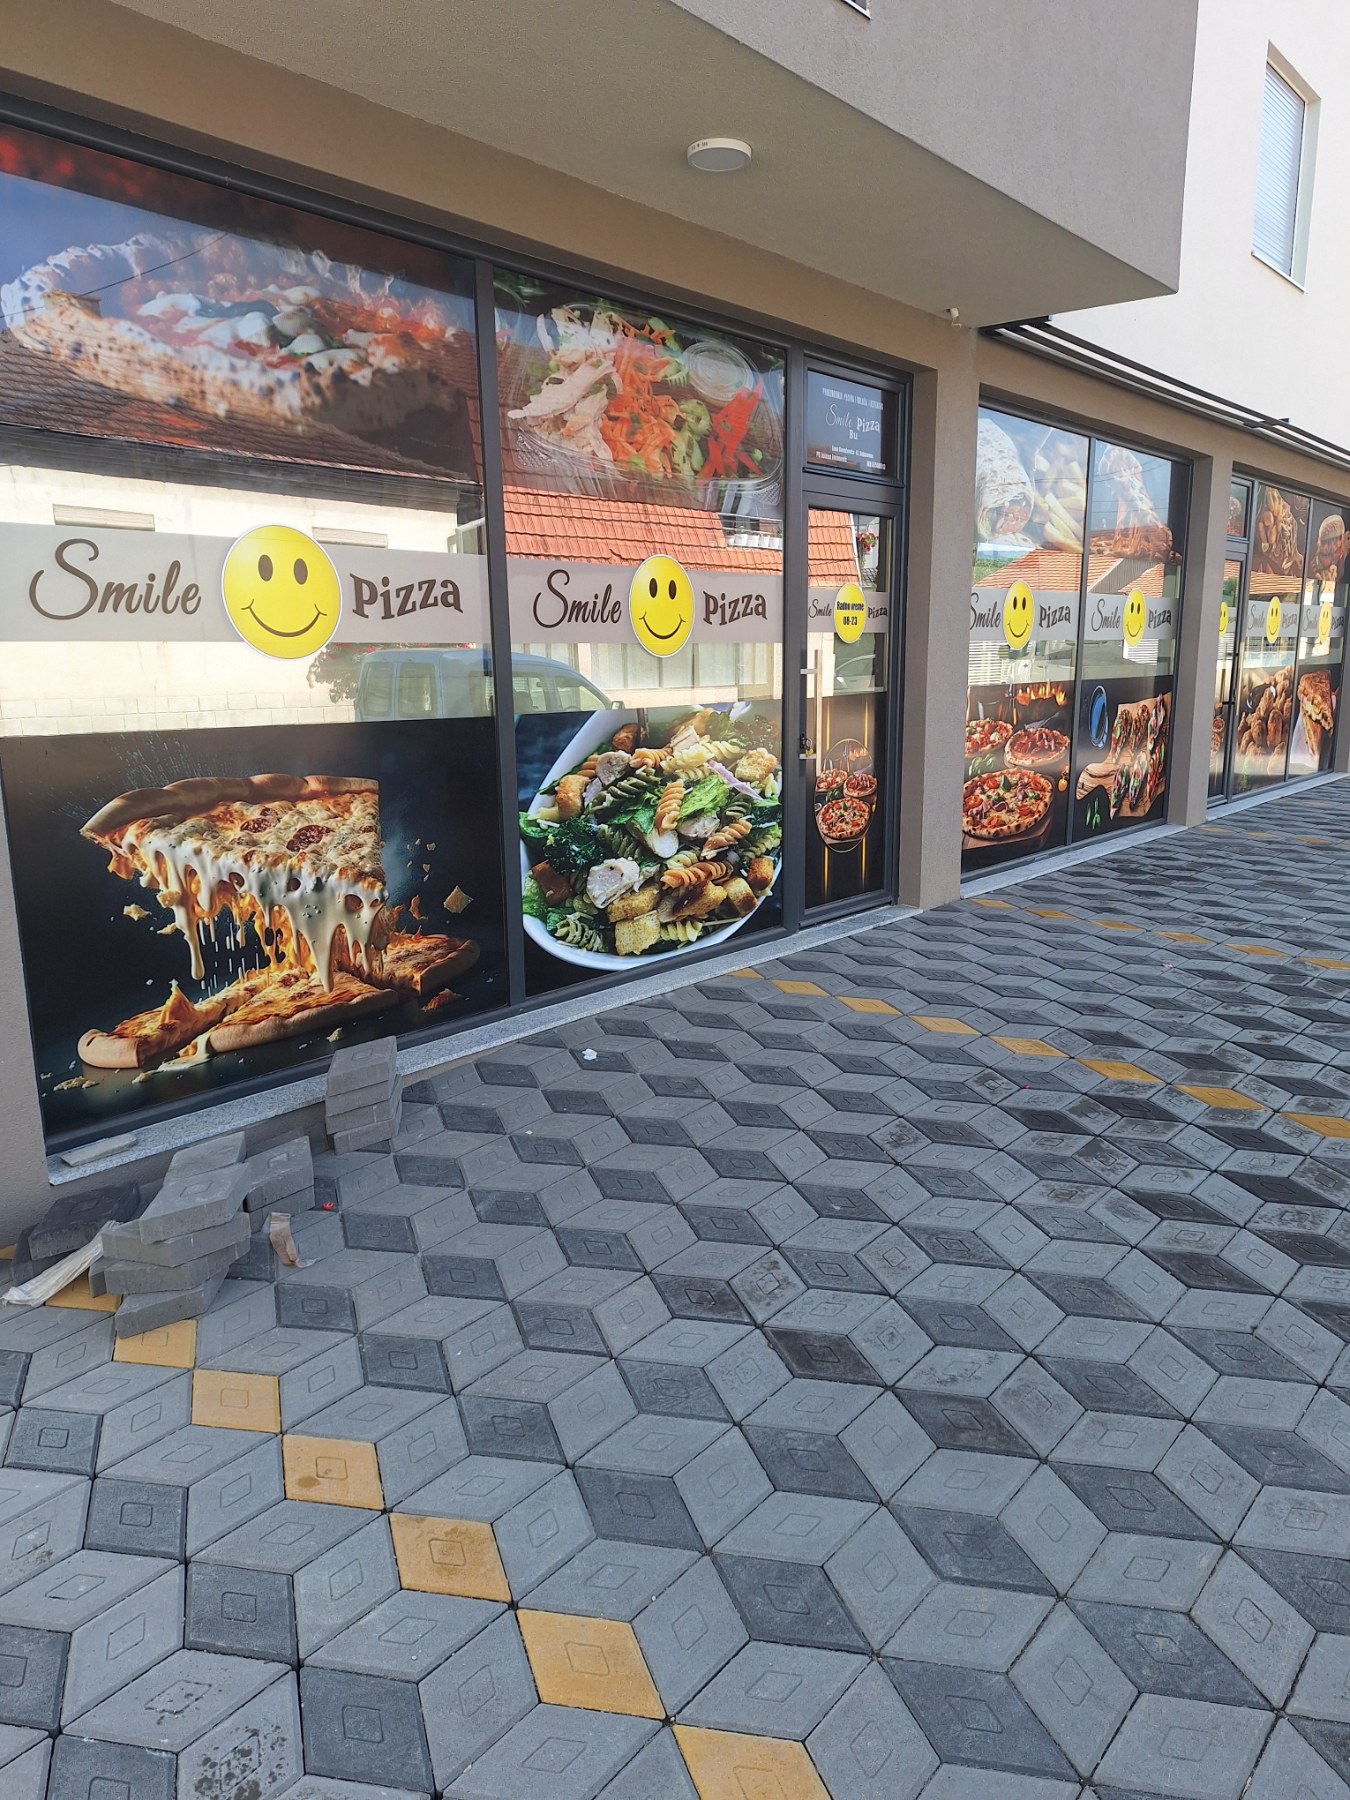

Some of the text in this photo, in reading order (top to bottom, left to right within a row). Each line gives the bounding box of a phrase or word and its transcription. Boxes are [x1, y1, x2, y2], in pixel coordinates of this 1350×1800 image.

[825, 403, 881, 434] Smile Pizza
[29, 538, 464, 621] Smile Pizza
[533, 569, 768, 628] Smile Pizza
[808, 598, 888, 619] Smile Pizza
[1038, 602, 1071, 629] Pizza
[1091, 598, 1172, 632] Smile Pizza
